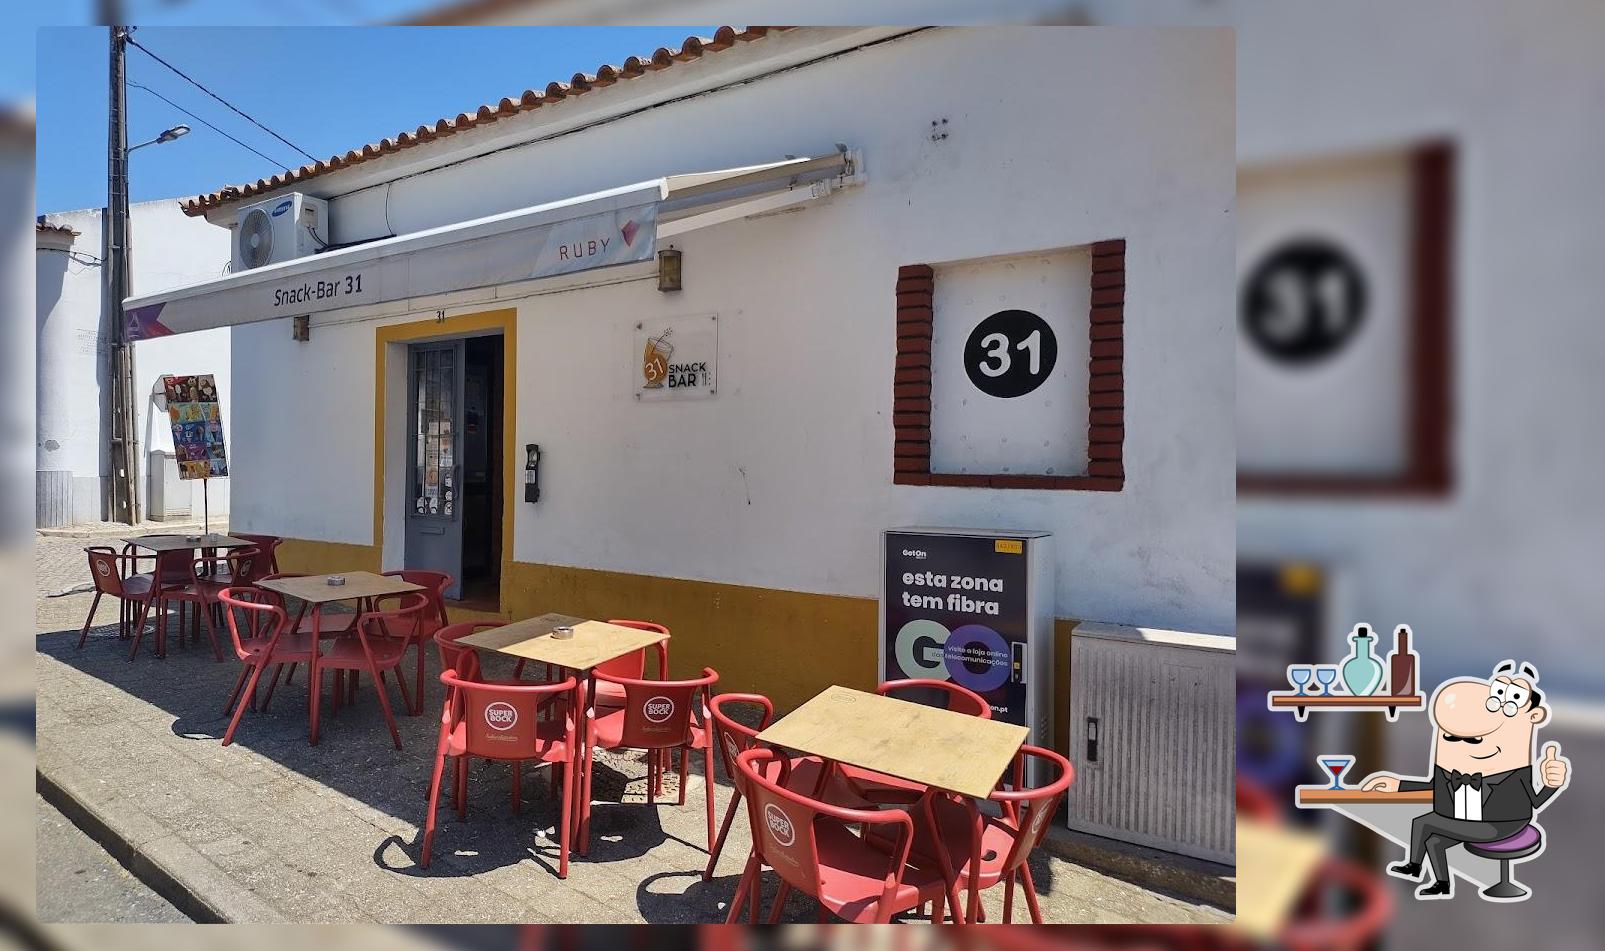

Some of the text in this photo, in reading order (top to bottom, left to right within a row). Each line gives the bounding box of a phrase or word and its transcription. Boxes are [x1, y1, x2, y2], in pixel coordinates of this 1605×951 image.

[559, 238, 610, 260] RUBY
[273, 273, 363, 307] Snack-Bar 31
[436, 310, 445, 324] 31
[979, 329, 1041, 378] 31
[645, 357, 664, 381] 31
[668, 361, 707, 374] SNACK
[668, 373, 697, 388] BAR
[902, 571, 1004, 593] esta zona
[902, 591, 999, 615] tem fibra
[972, 648, 986, 657] loja
[986, 649, 1009, 659] online
[488, 709, 513, 717] SUPER
